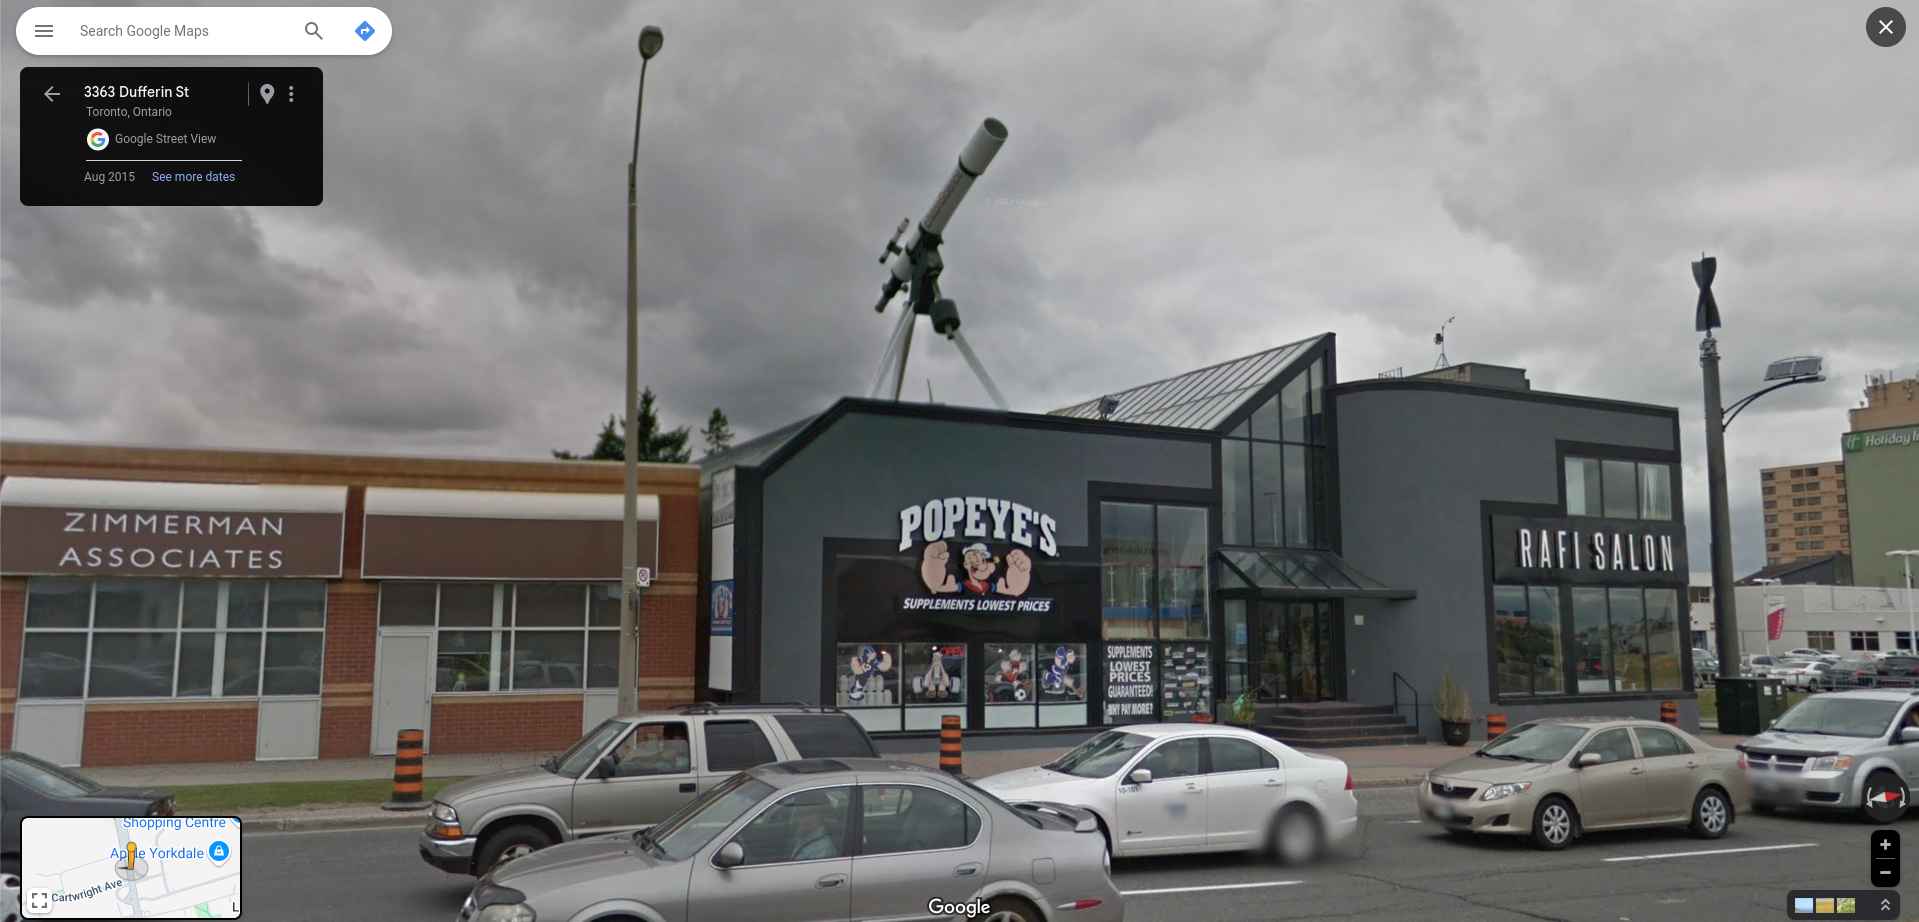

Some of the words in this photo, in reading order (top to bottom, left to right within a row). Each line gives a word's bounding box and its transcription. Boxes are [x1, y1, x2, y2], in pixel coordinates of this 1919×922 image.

[1865, 431, 1911, 447] Holiday
[63, 512, 284, 536] ZIMMERMAN
[899, 496, 1057, 557] POPEYE'S
[1520, 528, 1581, 569] RAFI
[1594, 532, 1673, 572] SALON
[58, 547, 283, 569] ASSOCIATES
[903, 597, 976, 610] SUPPLEMENTS
[976, 600, 1015, 611] LOWEST
[1016, 600, 1051, 612] PRICES
[1107, 645, 1153, 659] SUPPLEMENTS
[1109, 661, 1151, 672] LOWEST
[1109, 672, 1151, 683] PRICES
[1107, 684, 1154, 698] GUARANTEED!
[1107, 703, 1120, 715] WHY
[1120, 703, 1132, 715] PAY
[1132, 703, 1153, 715] MORE?
